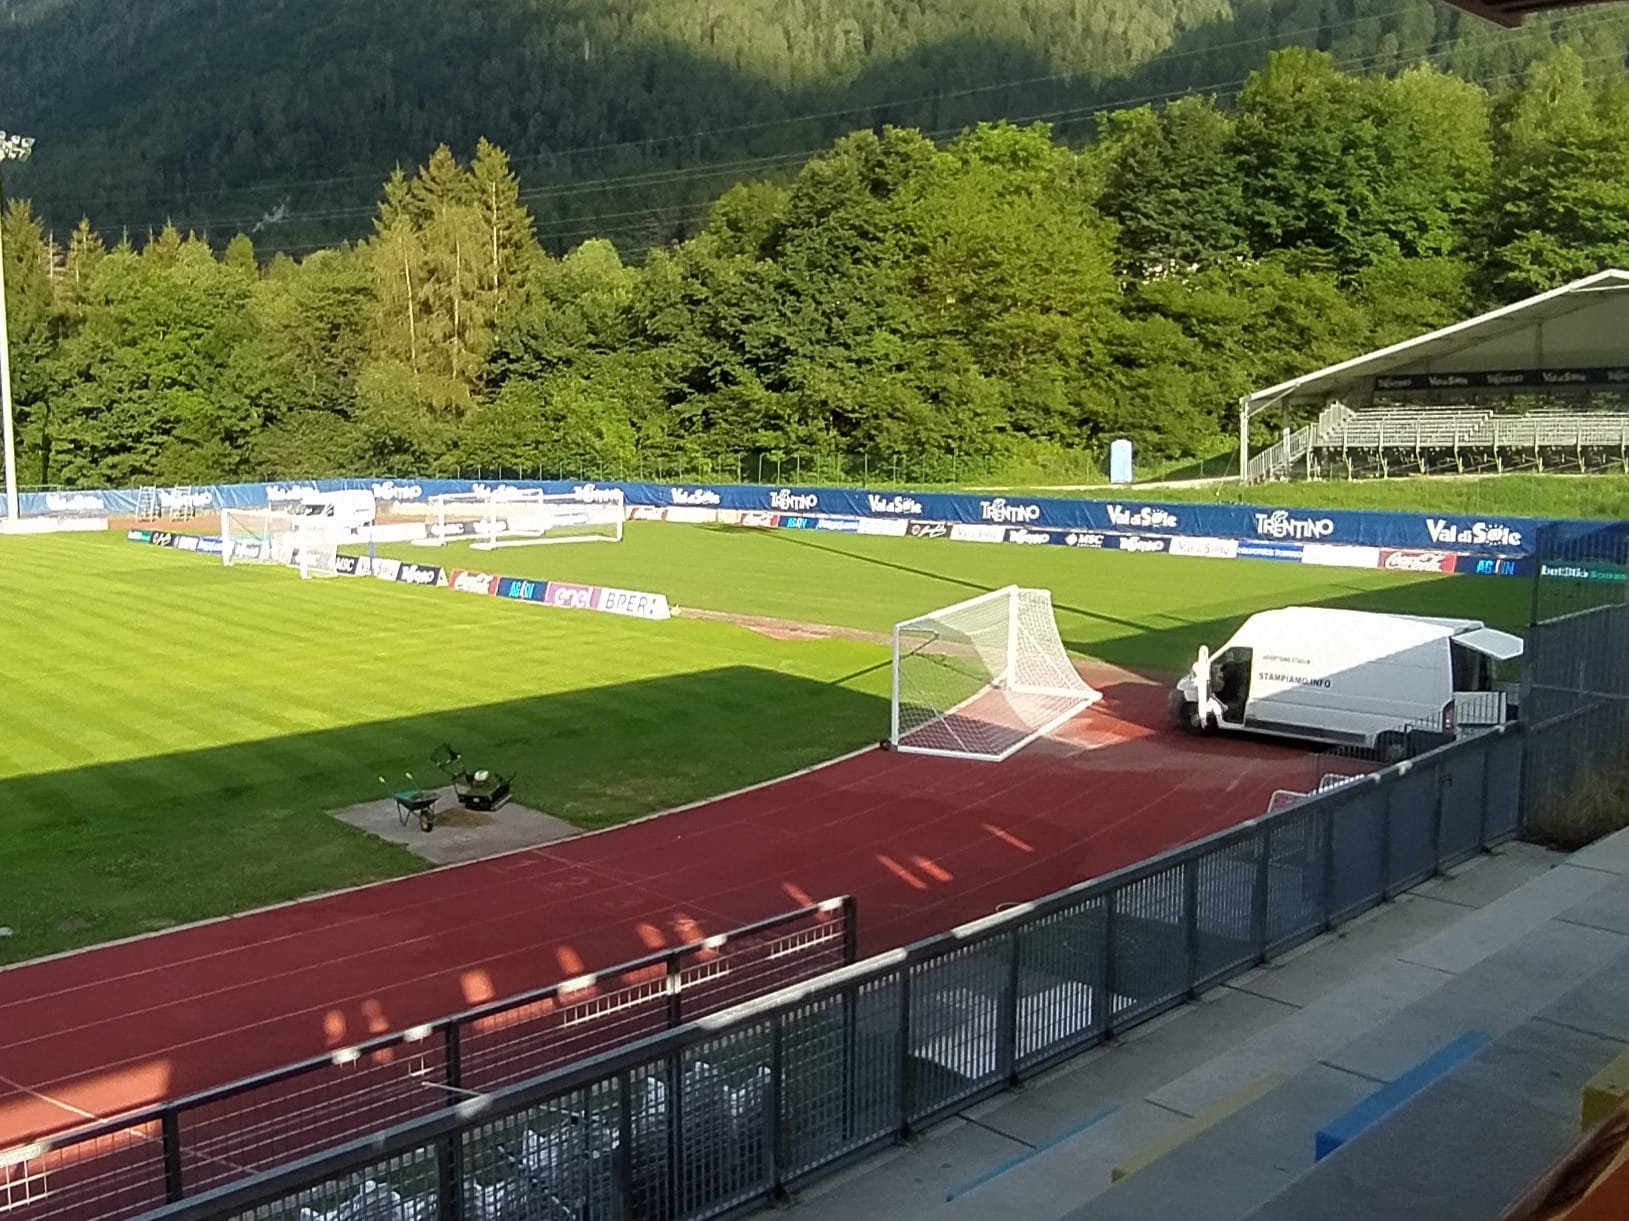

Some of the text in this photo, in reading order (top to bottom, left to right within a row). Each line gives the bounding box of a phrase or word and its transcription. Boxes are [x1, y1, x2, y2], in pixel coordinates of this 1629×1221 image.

[979, 497, 1041, 523] TRENTINO
[1255, 510, 1334, 540] TRENTINO
[1425, 518, 1458, 544] Val
[1472, 521, 1523, 546] Sole
[554, 587, 594, 609] enel
[1259, 672, 1332, 689] STAMPIAMO.INFO
